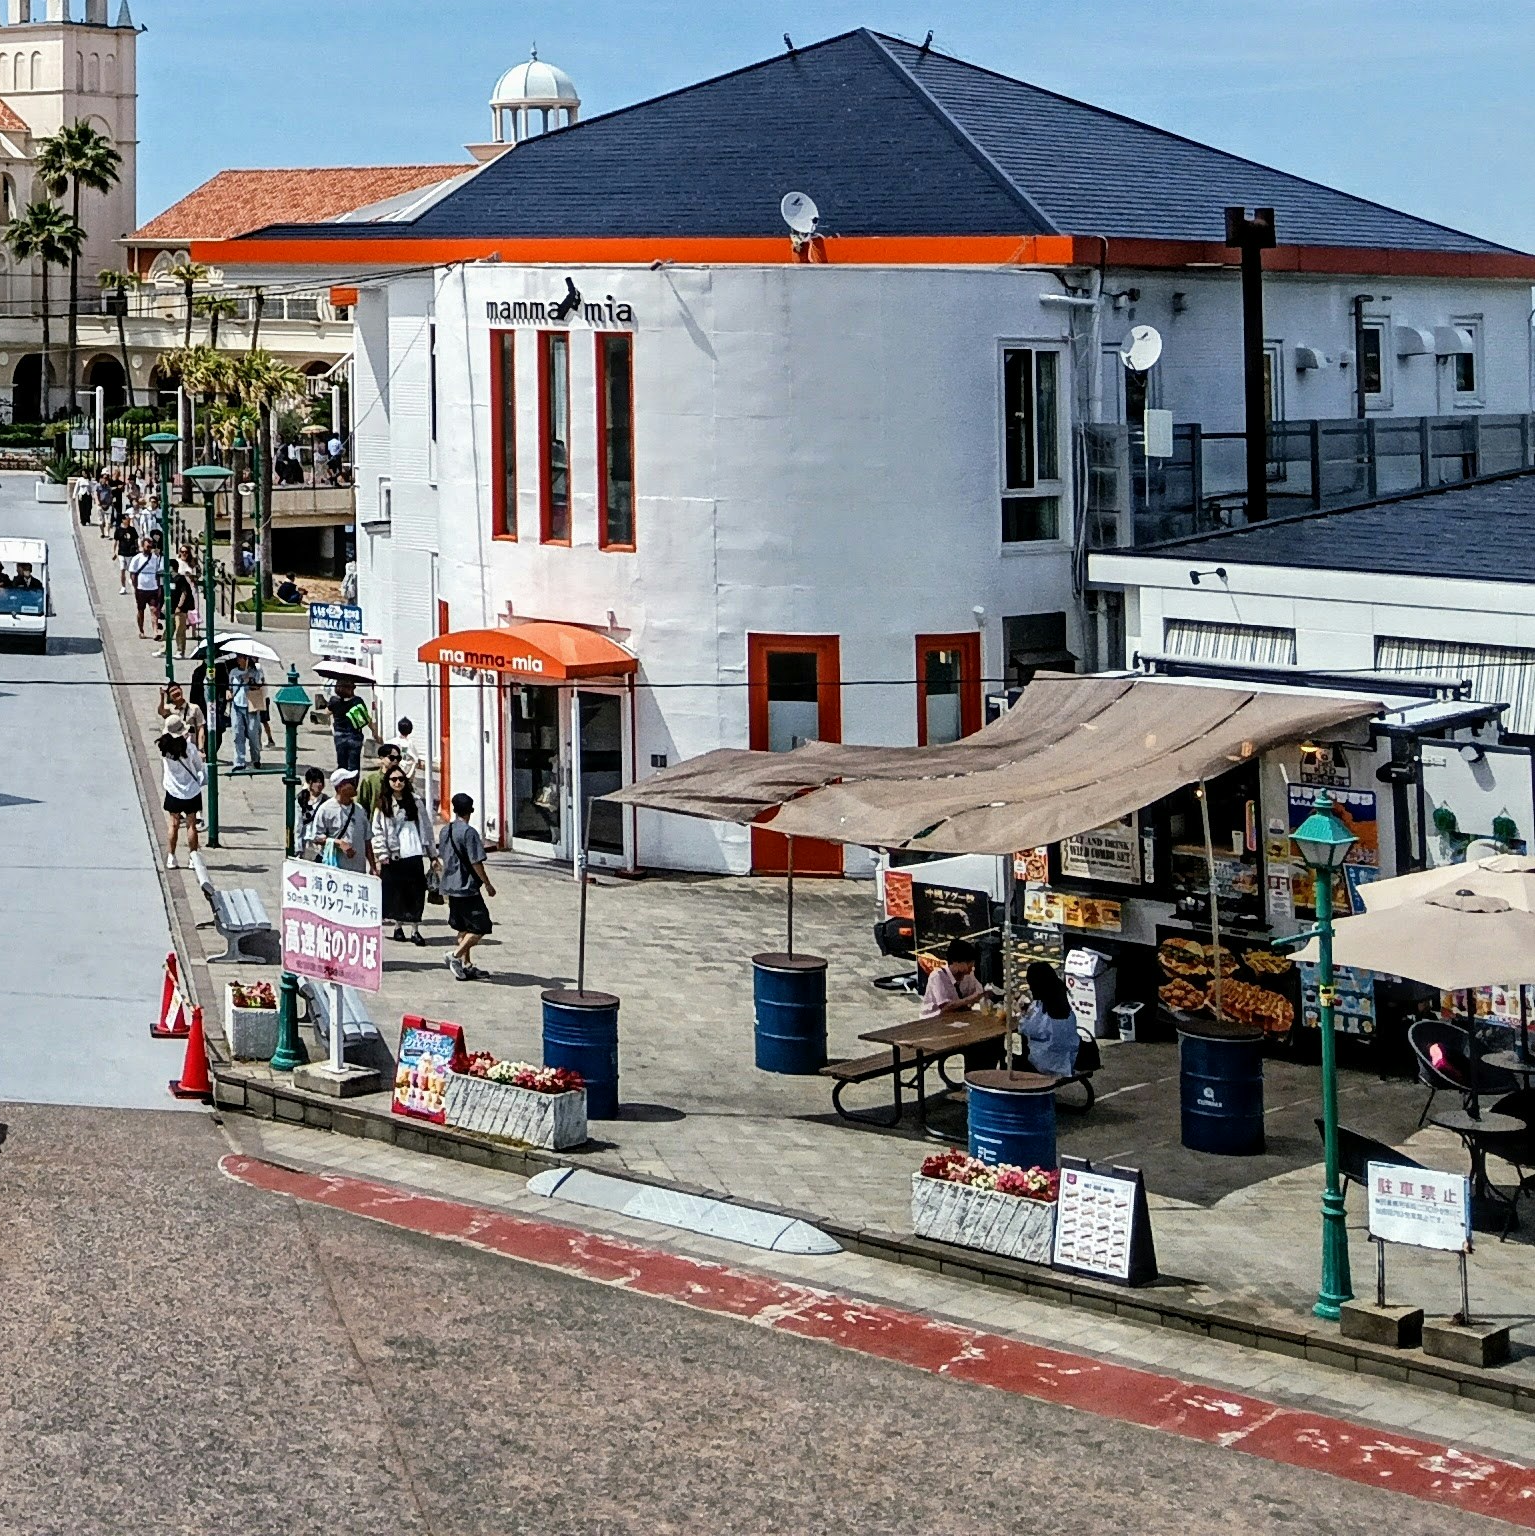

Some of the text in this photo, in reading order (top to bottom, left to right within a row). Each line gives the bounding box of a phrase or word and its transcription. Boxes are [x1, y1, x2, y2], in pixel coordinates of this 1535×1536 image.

[486, 295, 633, 322] mamma mia
[439, 648, 543, 672] mamma-mia
[1087, 837, 1103, 847] AND
[1104, 839, 1130, 851] DRINK
[1091, 847, 1115, 861] COMBO
[1116, 851, 1131, 863] SET
[285, 918, 378, 971] 高速船のりば
[1376, 1177, 1458, 1204] 駐車禁止
